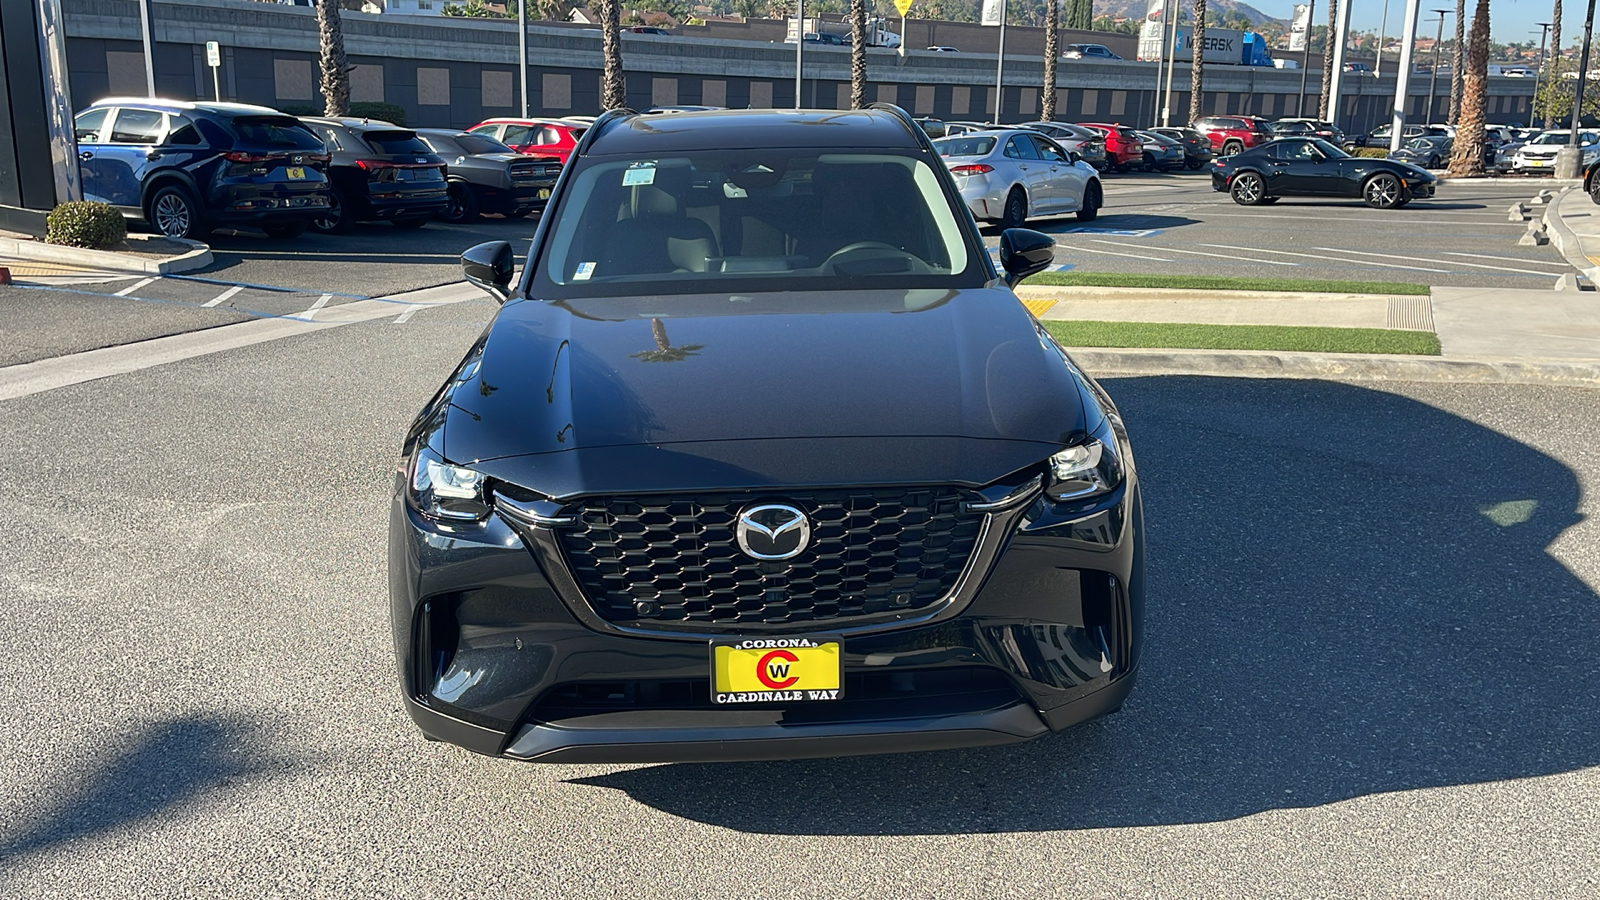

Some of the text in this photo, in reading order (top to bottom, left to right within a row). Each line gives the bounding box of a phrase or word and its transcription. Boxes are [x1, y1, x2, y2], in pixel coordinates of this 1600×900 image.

[1186, 36, 1234, 52] MERSK
[742, 639, 811, 648] CORONA
[717, 690, 840, 703] CARDINALE WAY
